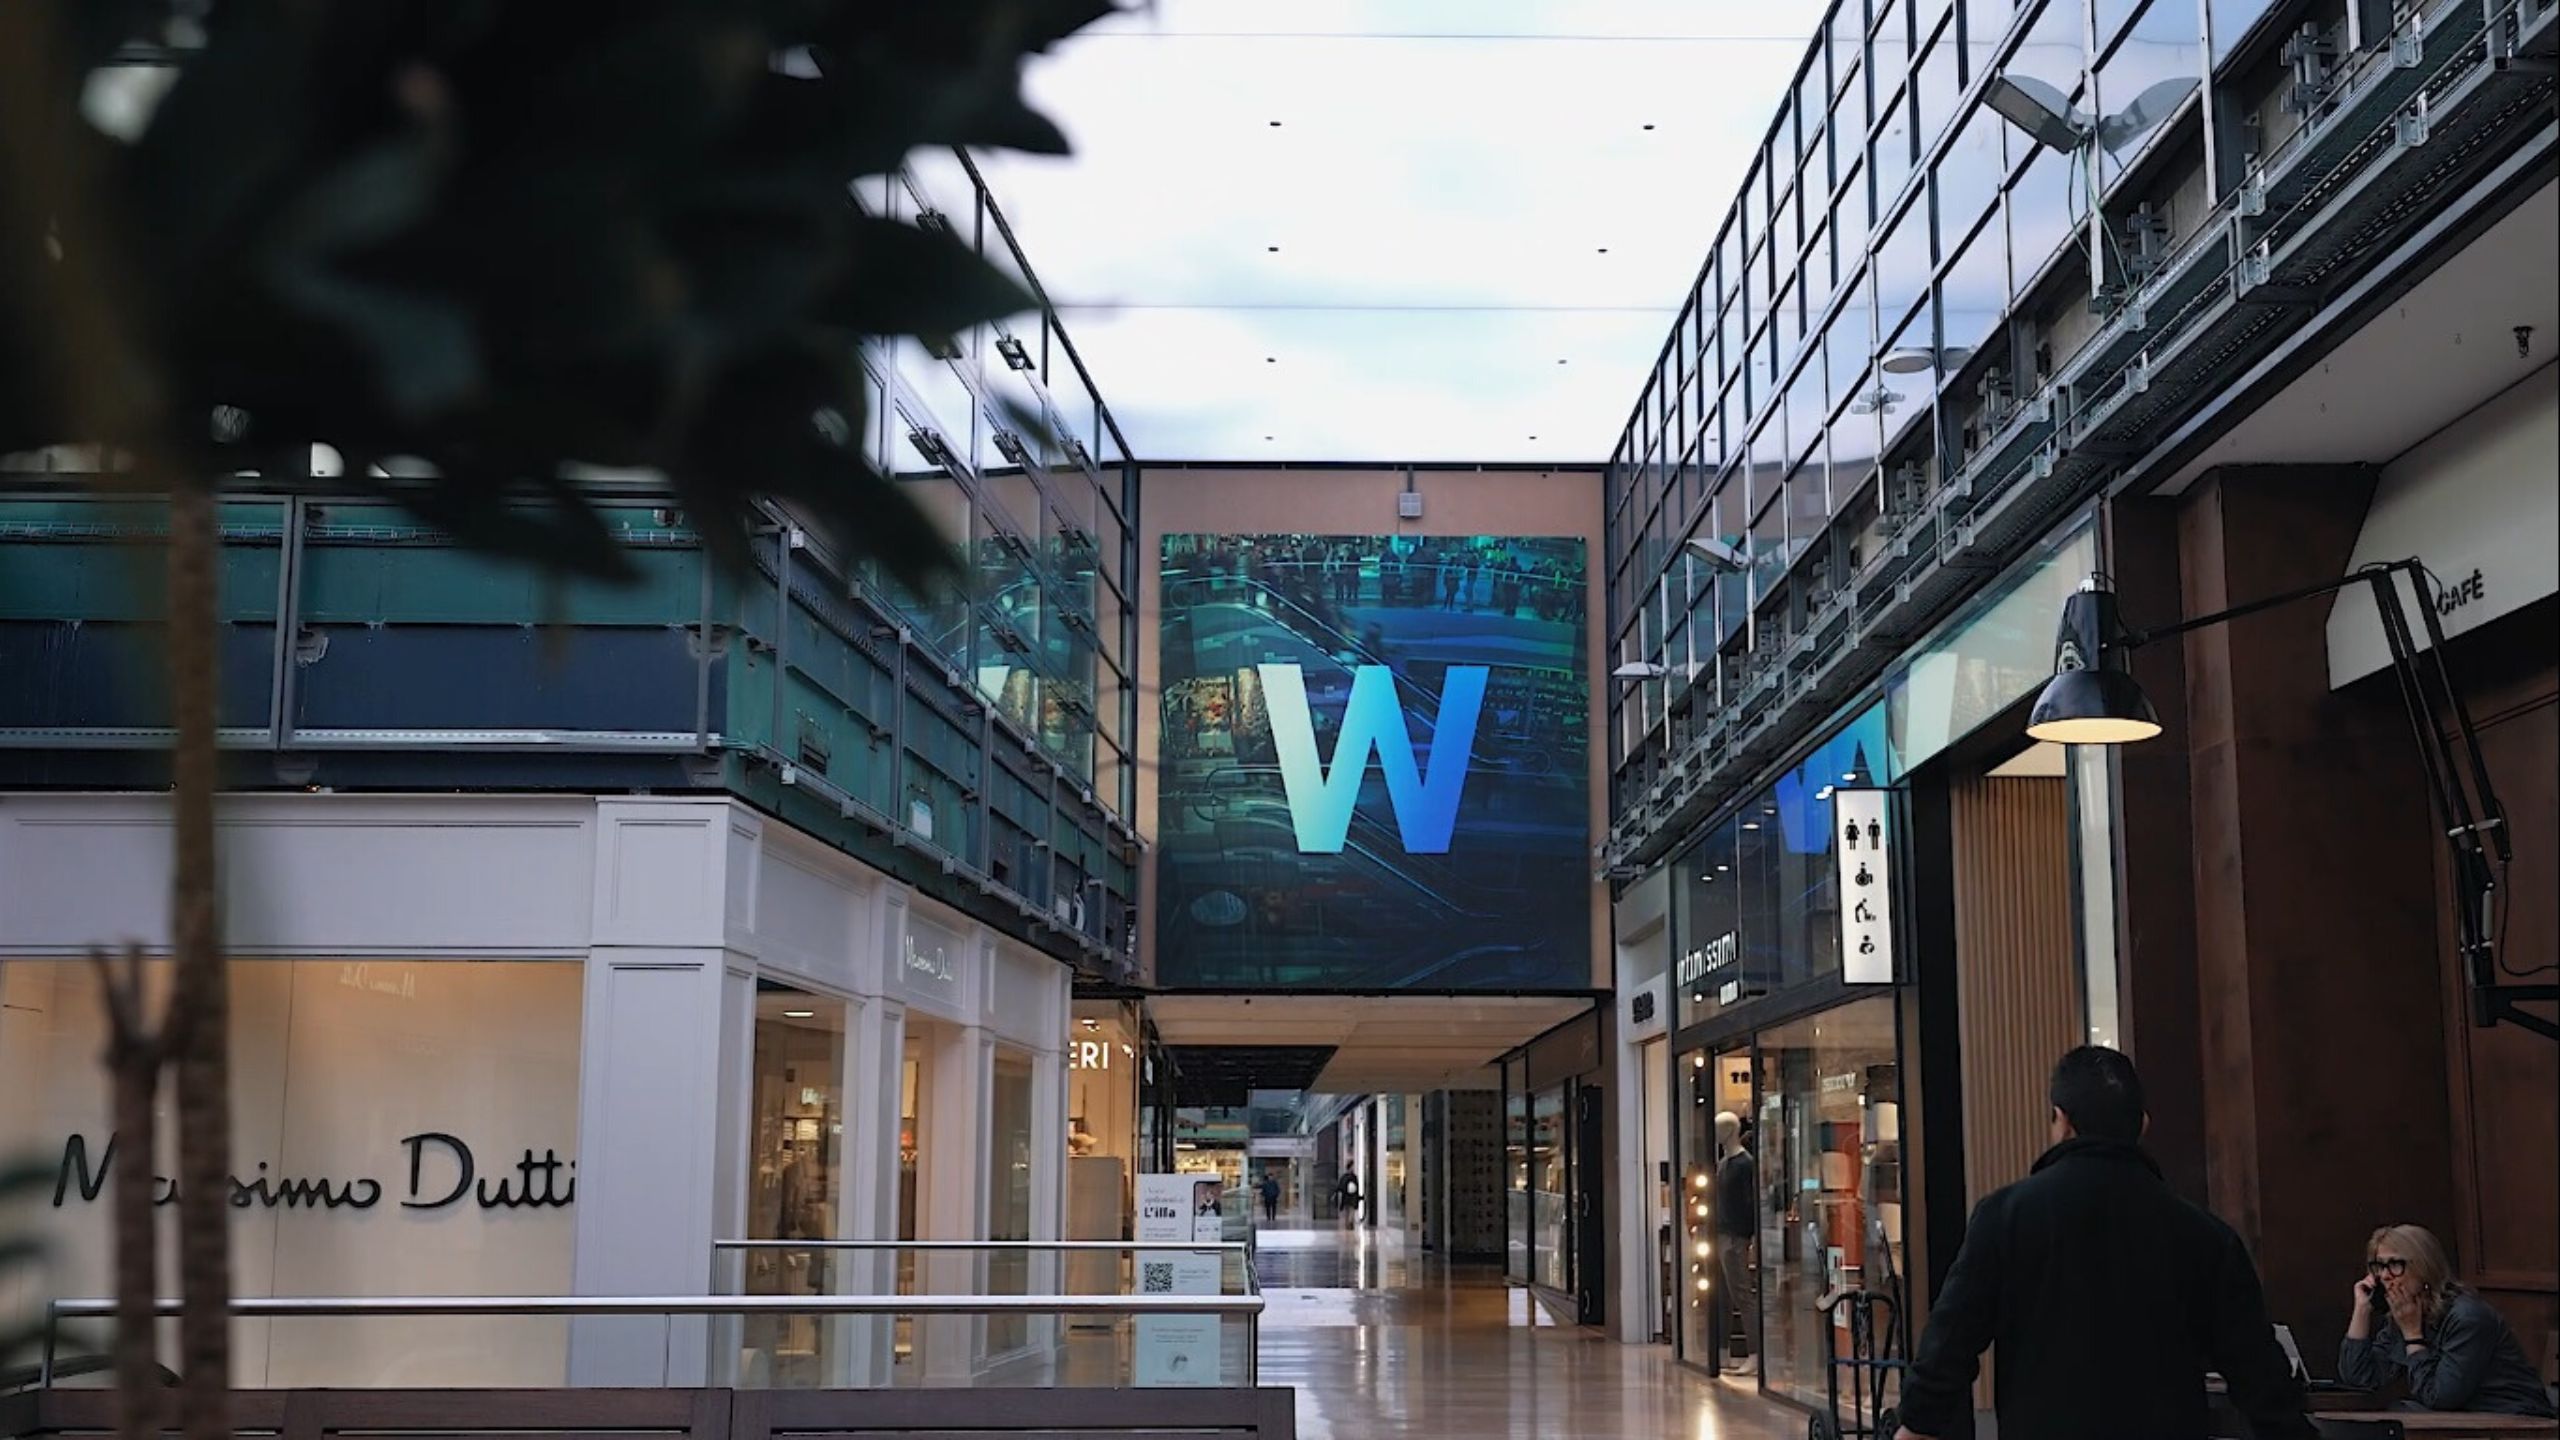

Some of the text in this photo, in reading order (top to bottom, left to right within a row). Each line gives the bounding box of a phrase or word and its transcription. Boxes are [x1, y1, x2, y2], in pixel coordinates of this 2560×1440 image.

[2436, 568, 2484, 615] CAFÉ
[1257, 663, 1490, 854] W
[53, 1132, 575, 1209] Masimo Dutti
